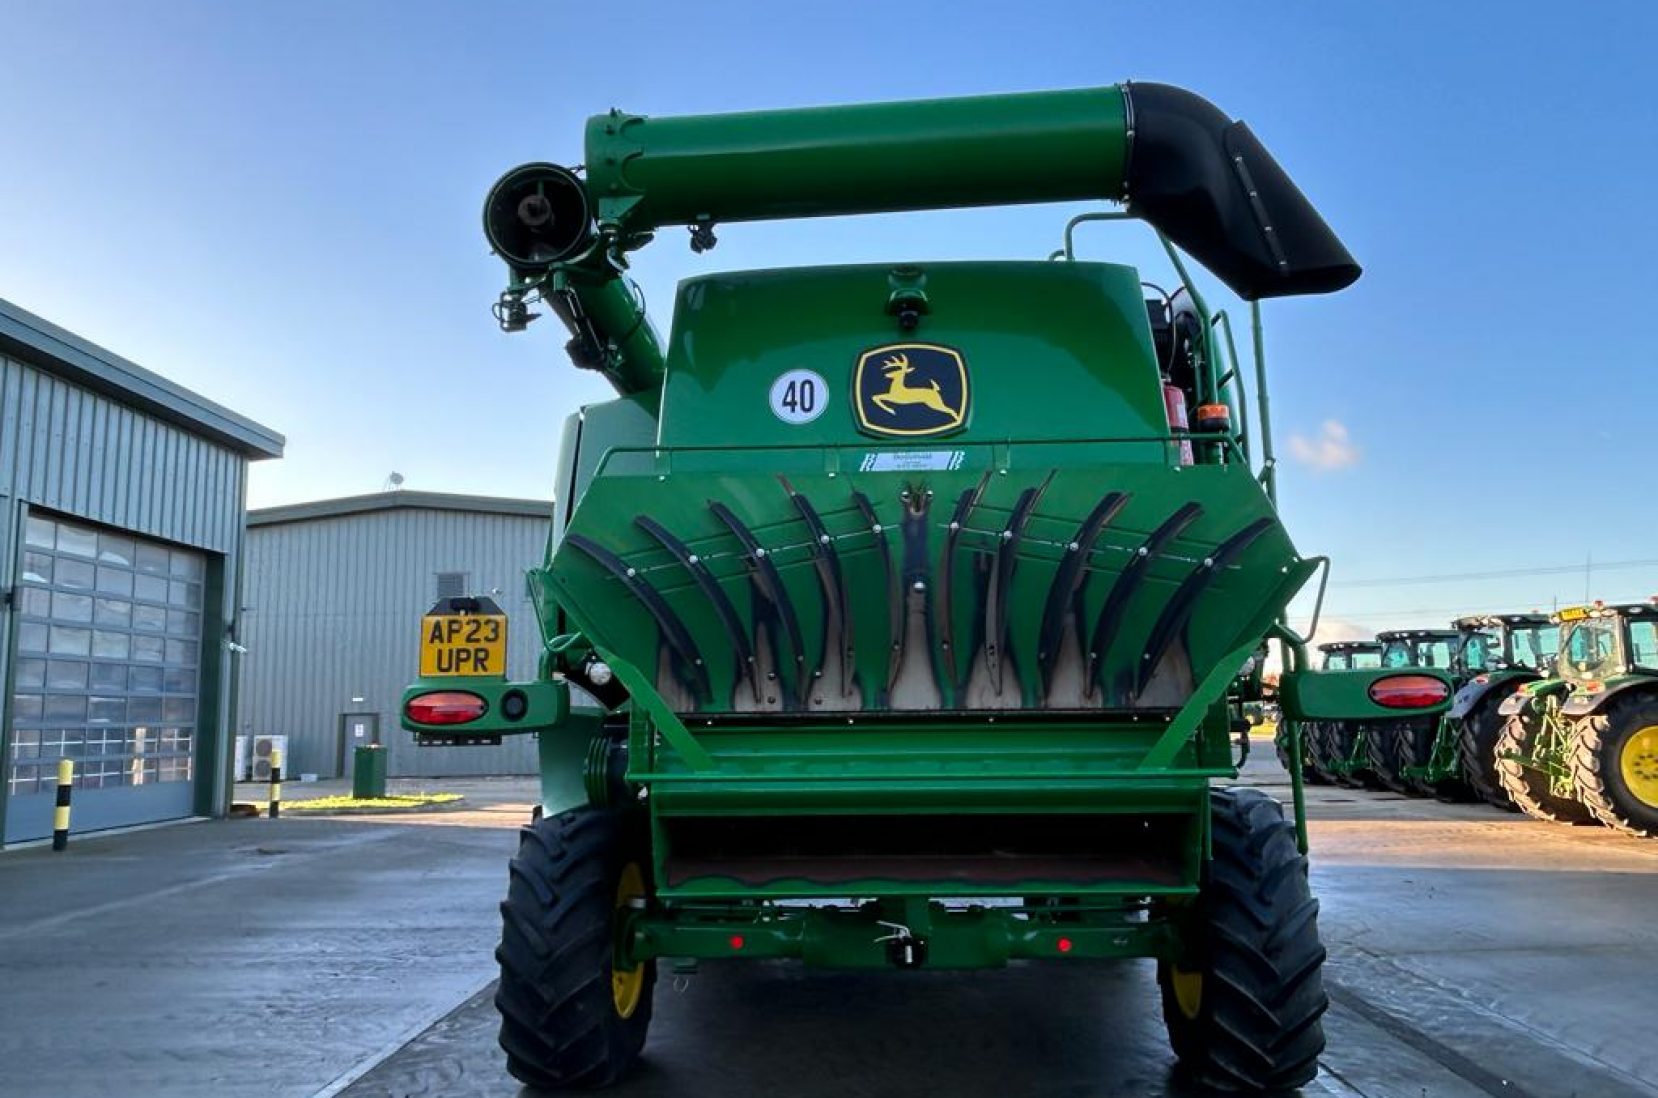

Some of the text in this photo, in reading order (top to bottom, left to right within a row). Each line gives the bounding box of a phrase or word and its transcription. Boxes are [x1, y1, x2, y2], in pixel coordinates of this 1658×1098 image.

[782, 379, 814, 413] 40
[429, 619, 500, 643] AP23
[436, 647, 489, 672] UPR
